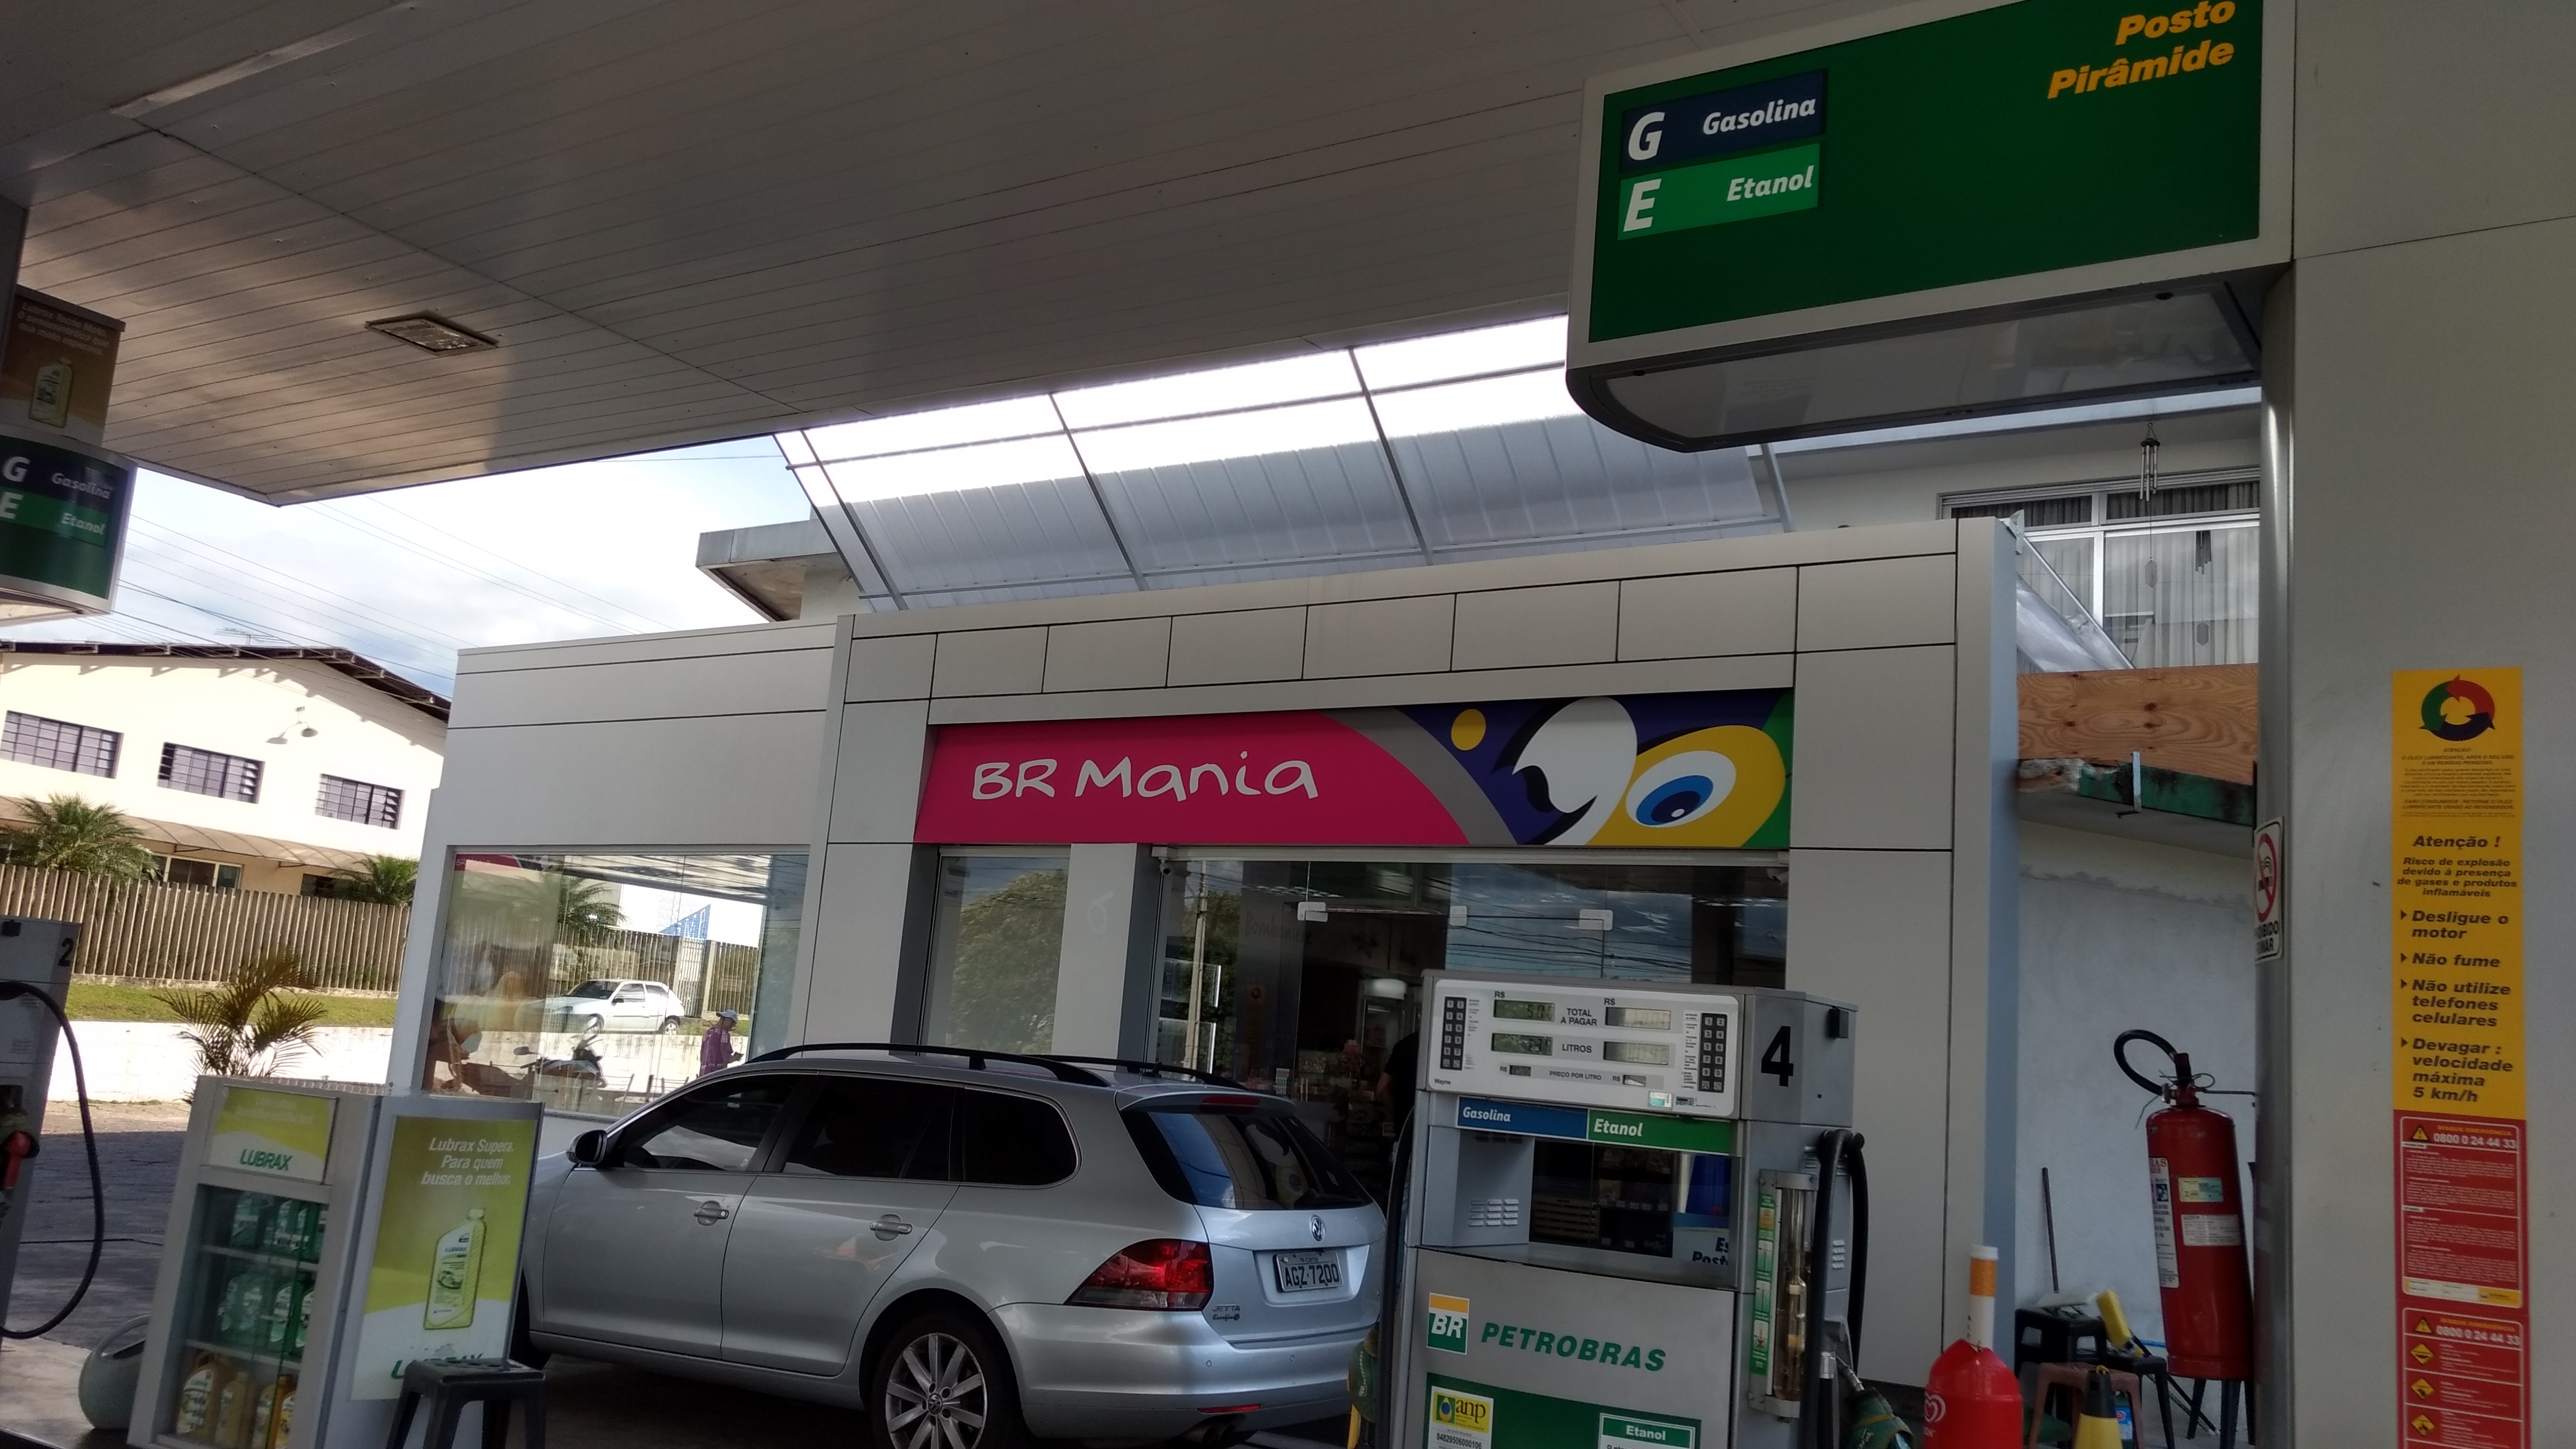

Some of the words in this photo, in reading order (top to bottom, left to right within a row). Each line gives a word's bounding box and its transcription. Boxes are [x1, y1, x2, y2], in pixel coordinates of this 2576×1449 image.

[2115, 0, 2236, 45] Posto
[2047, 39, 2234, 100] Pirâmide
[1628, 111, 1665, 161] G
[1703, 98, 1816, 135] Gasolina
[1623, 178, 1662, 232] E
[1726, 165, 1815, 202] Etanol
[2, 456, 31, 482] G
[51, 472, 111, 500] Gasolina
[0, 491, 23, 519] E
[60, 512, 106, 534] Etanol
[972, 757, 1057, 800] BR
[1074, 750, 1318, 802] Mania
[2413, 835, 2488, 850] Atenção
[2403, 857, 2435, 865] Risco
[2439, 858, 2452, 866] de
[2457, 858, 2510, 867] explosão
[2403, 868, 2441, 876] devido
[2456, 869, 2511, 878] presença
[2415, 878, 2449, 887] gases
[2463, 879, 2517, 888] produtos
[2423, 888, 2490, 897] inflamáveis
[2412, 910, 2491, 925] Desligue
[2498, 915, 2509, 925] o
[2412, 927, 2467, 939] motor
[58, 937, 73, 966] 2
[2412, 953, 2447, 965] Não
[2454, 954, 2501, 967] fume
[2412, 979, 2447, 992] Não
[2454, 982, 2511, 995] utilize
[2412, 996, 2498, 1011] telefones
[1566, 1008, 1592, 1017] TOTAL
[2412, 1012, 2497, 1027] celulares
[1569, 1017, 1597, 1026] PAGAR
[1562, 1044, 1592, 1053] LITROS
[2412, 1038, 2490, 1055] Devagar
[1761, 1025, 1794, 1087] 4
[2412, 1055, 2513, 1072] velocidade
[2412, 1071, 2484, 1086] máxima
[2413, 1086, 2425, 1098] 5
[2430, 1087, 2478, 1102] km/h
[1462, 1106, 1511, 1122] Gasolina
[1593, 1118, 1644, 1138] Etanol
[429, 1137, 475, 1152] Lubrax
[477, 1139, 514, 1155] Supera.
[2433, 1133, 2460, 1144] 0800
[2461, 1135, 2468, 1144] 0
[2470, 1136, 2484, 1146] 24
[2487, 1137, 2501, 1147] 44
[2502, 1139, 2516, 1149] 33
[240, 1149, 293, 1171] LUBRAX
[441, 1154, 471, 1168] Para
[473, 1158, 504, 1171] quem
[420, 1171, 462, 1185] busca
[465, 1175, 473, 1185] o
[475, 1172, 511, 1185] melhor.
[1431, 1313, 1464, 1339] BR
[1481, 1322, 1666, 1372] PETROBRAS
[1456, 1399, 1486, 1424] anp
[1626, 1424, 1666, 1441] Etanol
